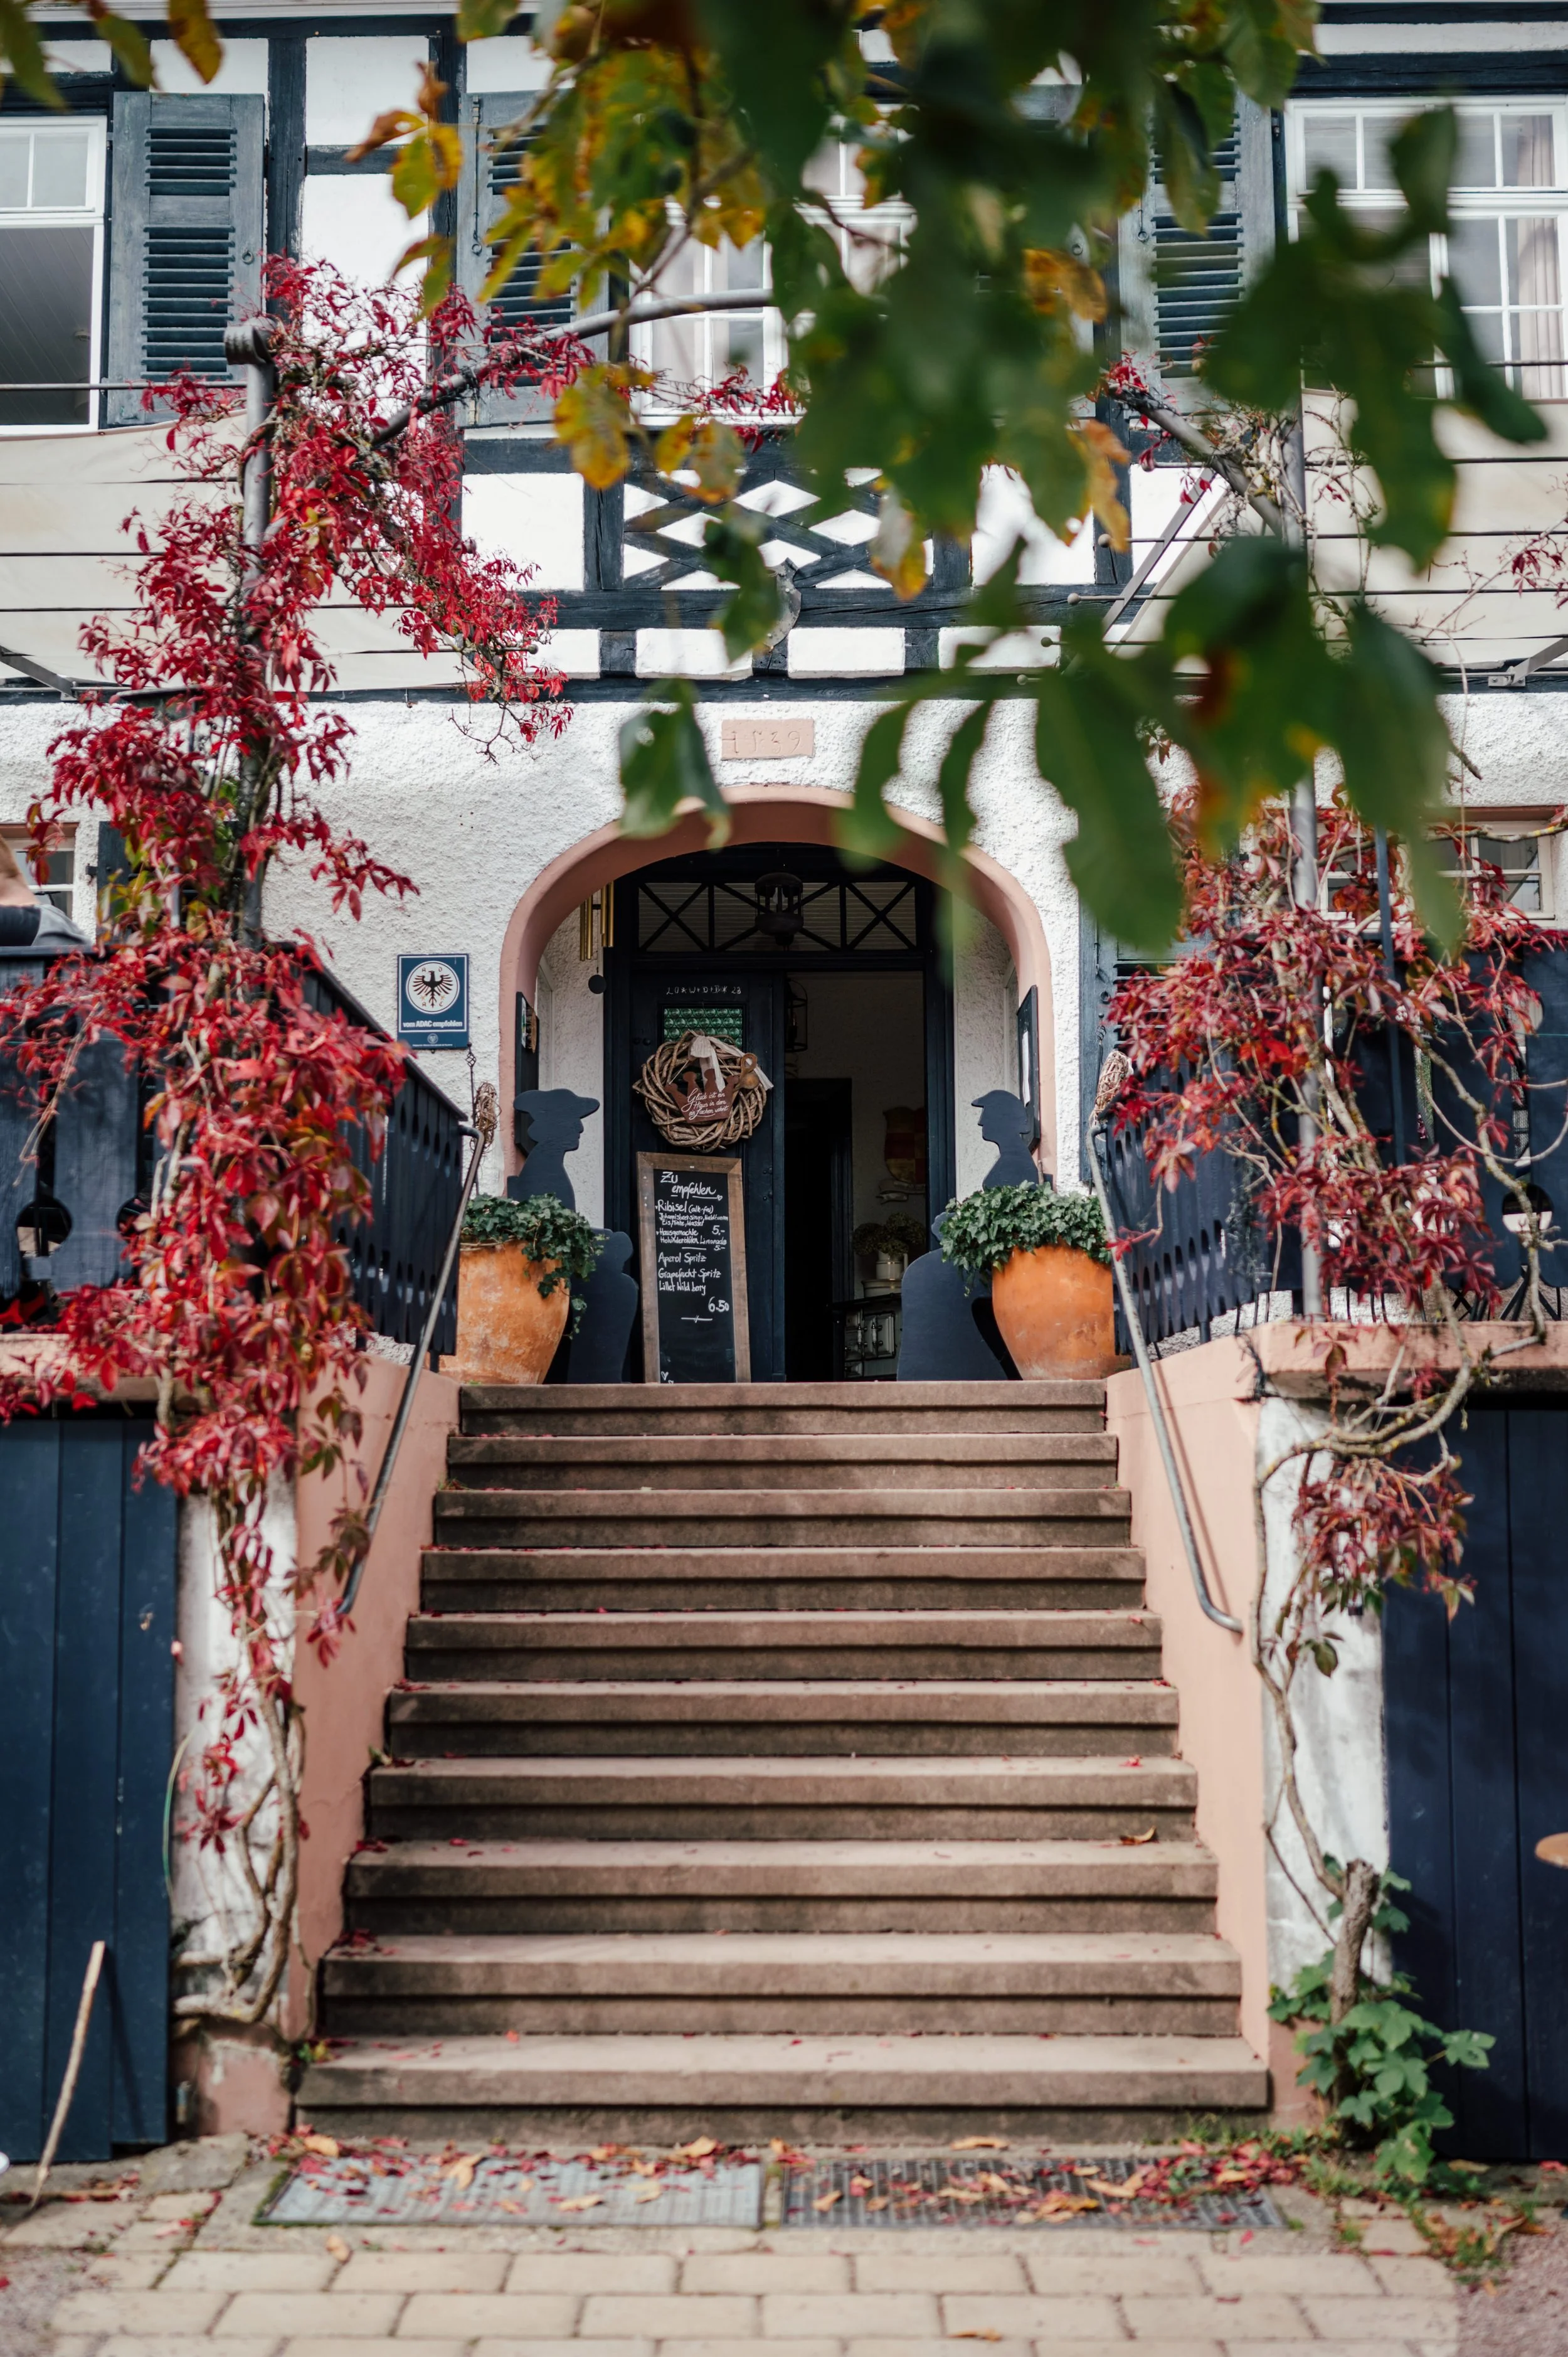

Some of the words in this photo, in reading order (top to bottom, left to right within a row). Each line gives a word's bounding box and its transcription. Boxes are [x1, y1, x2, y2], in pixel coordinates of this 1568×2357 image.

[433, 1019, 463, 1028] empfohlen
[681, 1088, 707, 1112] Glück
[693, 1101, 709, 1109] Haus
[672, 1182, 716, 1199] empfehlen
[657, 1200, 687, 1213] Ribisel
[688, 1205, 714, 1215] (alk-frei)
[660, 1228, 698, 1238] Hausgemachte
[700, 1235, 727, 1245] Limonade
[658, 1252, 681, 1267] Aperol
[684, 1252, 707, 1265] Spritz
[698, 1269, 721, 1283] Spritz
[659, 1280, 675, 1292] Lillet
[708, 1296, 729, 1312] 6.50
